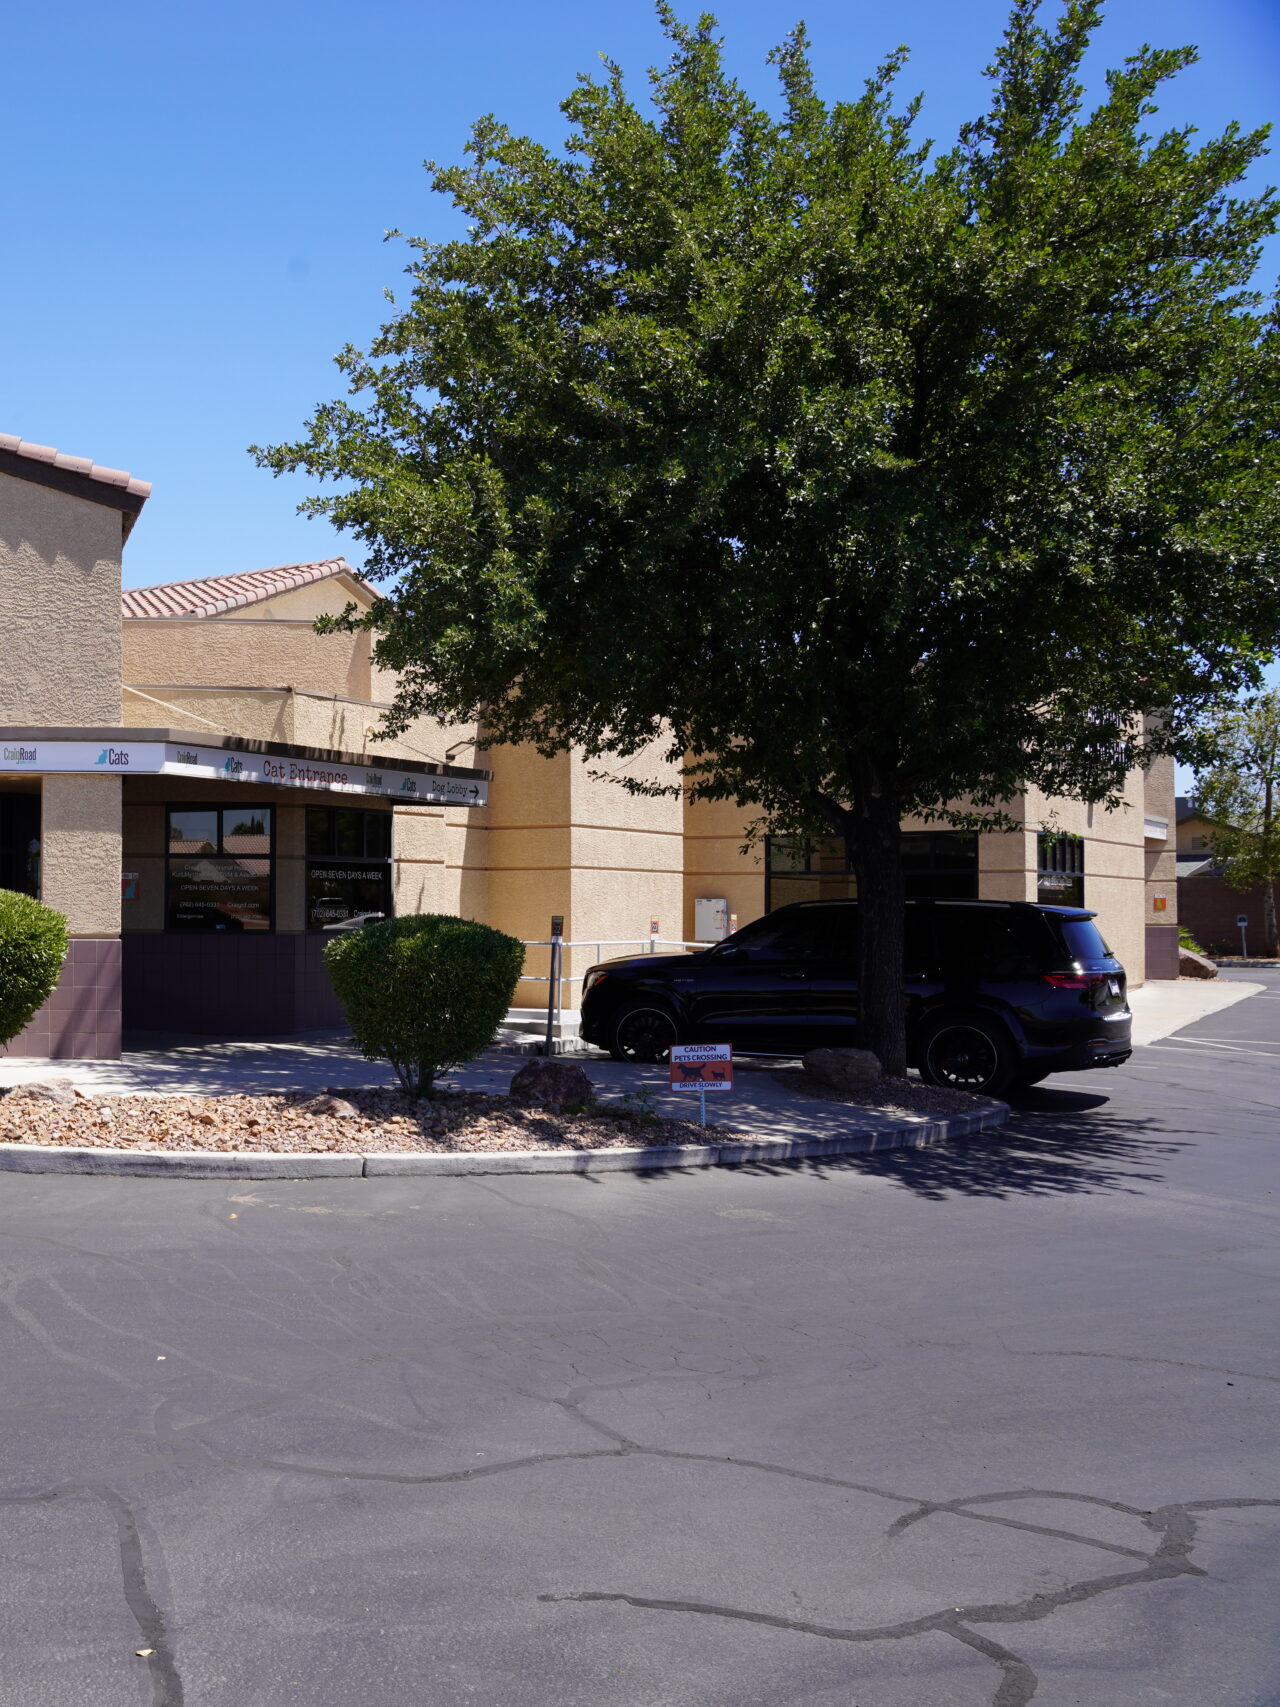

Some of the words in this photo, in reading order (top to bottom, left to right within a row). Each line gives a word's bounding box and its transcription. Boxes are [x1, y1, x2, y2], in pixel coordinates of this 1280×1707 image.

[4, 747, 37, 764] CraigRoad
[108, 748, 129, 765] Cats
[230, 757, 243, 773] Cats
[263, 760, 286, 778] Cat
[289, 763, 348, 785] Entrance
[432, 780, 445, 794] Dog
[447, 782, 468, 797] Lobby
[311, 870, 328, 878] OPEN
[328, 870, 347, 879] SEVEN
[347, 871, 362, 879] DAYS
[367, 872, 383, 880] WEEK
[684, 1045, 716, 1053] CAUTION
[691, 1053, 728, 1061] CROSSING
